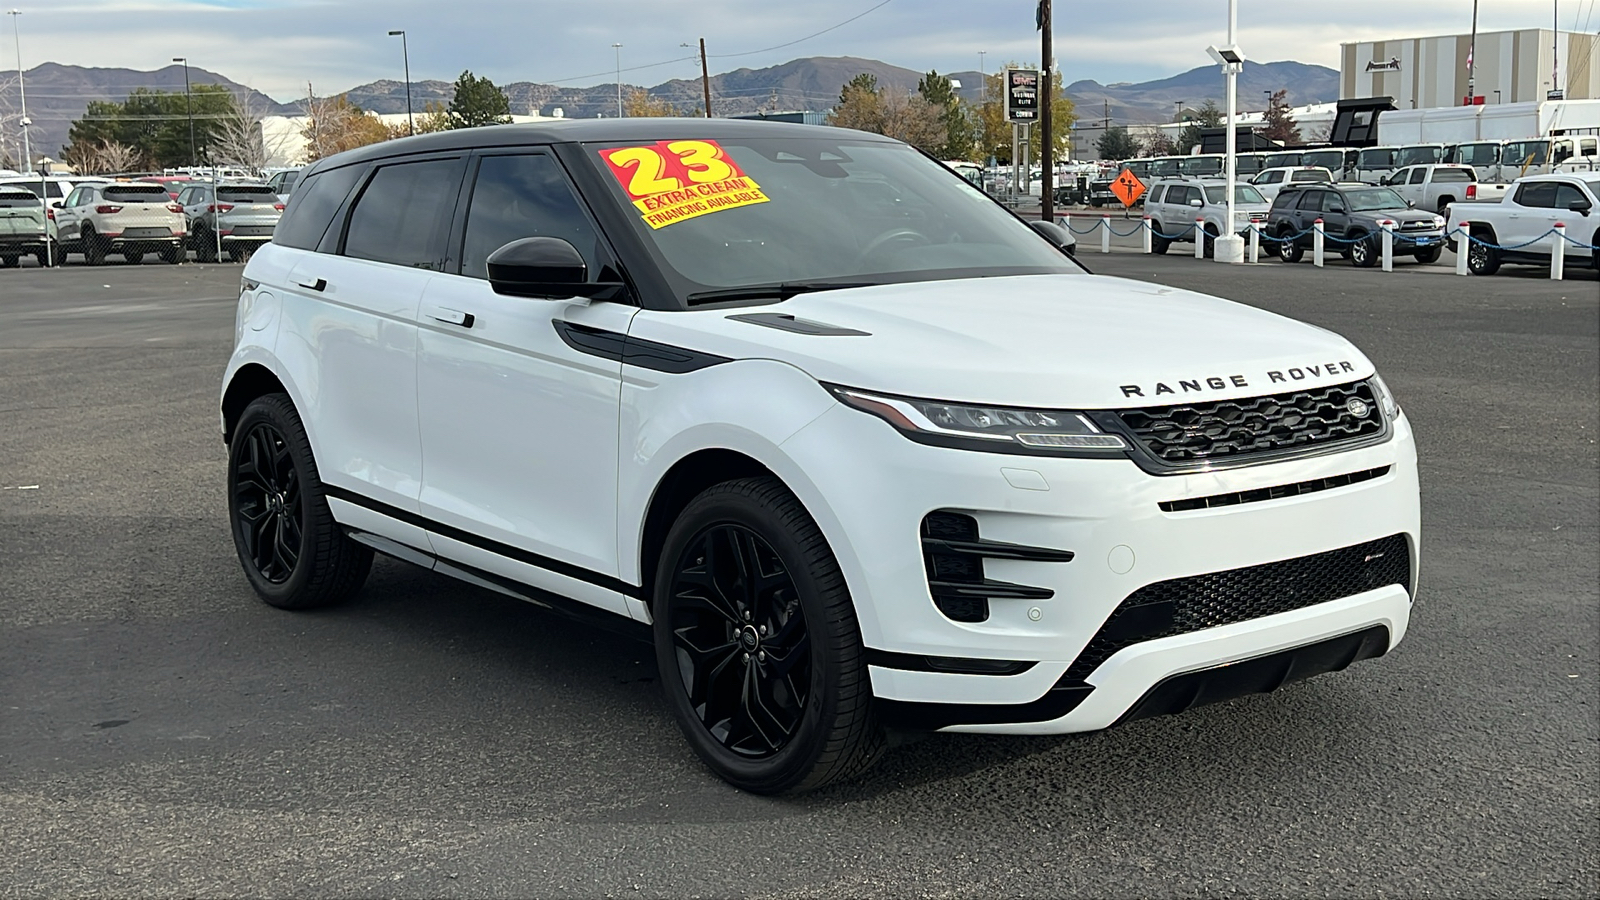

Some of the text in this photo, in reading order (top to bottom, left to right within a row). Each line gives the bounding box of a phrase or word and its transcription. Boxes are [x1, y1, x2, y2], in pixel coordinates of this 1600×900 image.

[1013, 77, 1036, 85] GMC
[608, 140, 738, 197] 23
[643, 179, 747, 211] EXTRA CLEAN
[648, 190, 763, 225] FINANCING AVAILABLE
[1119, 360, 1354, 398] RANGE ROVER
